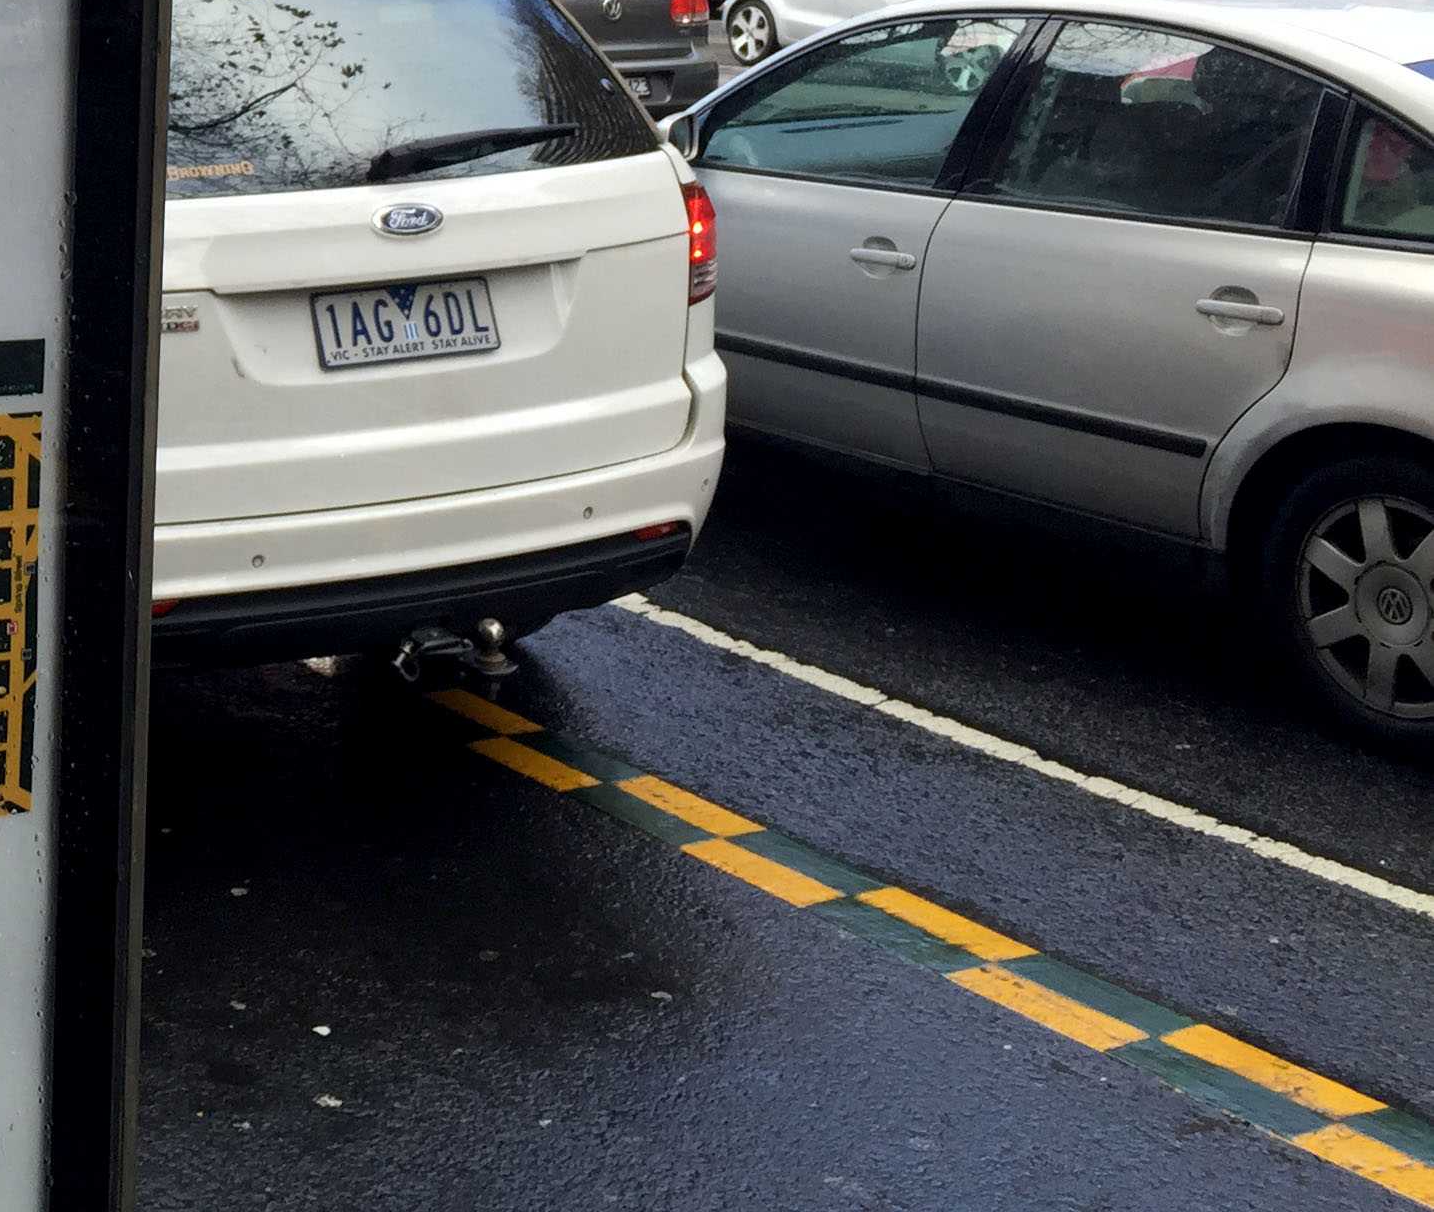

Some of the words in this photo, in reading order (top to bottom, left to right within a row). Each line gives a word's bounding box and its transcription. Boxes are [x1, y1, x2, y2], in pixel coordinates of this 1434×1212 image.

[388, 208, 428, 229] Ford
[326, 297, 395, 349] 1AG
[423, 288, 490, 338] 6DL
[331, 351, 350, 361] VIC
[363, 347, 389, 359] STAY
[393, 342, 425, 355] ALERT
[431, 338, 458, 351] STAY
[461, 334, 491, 347] ALIVE
